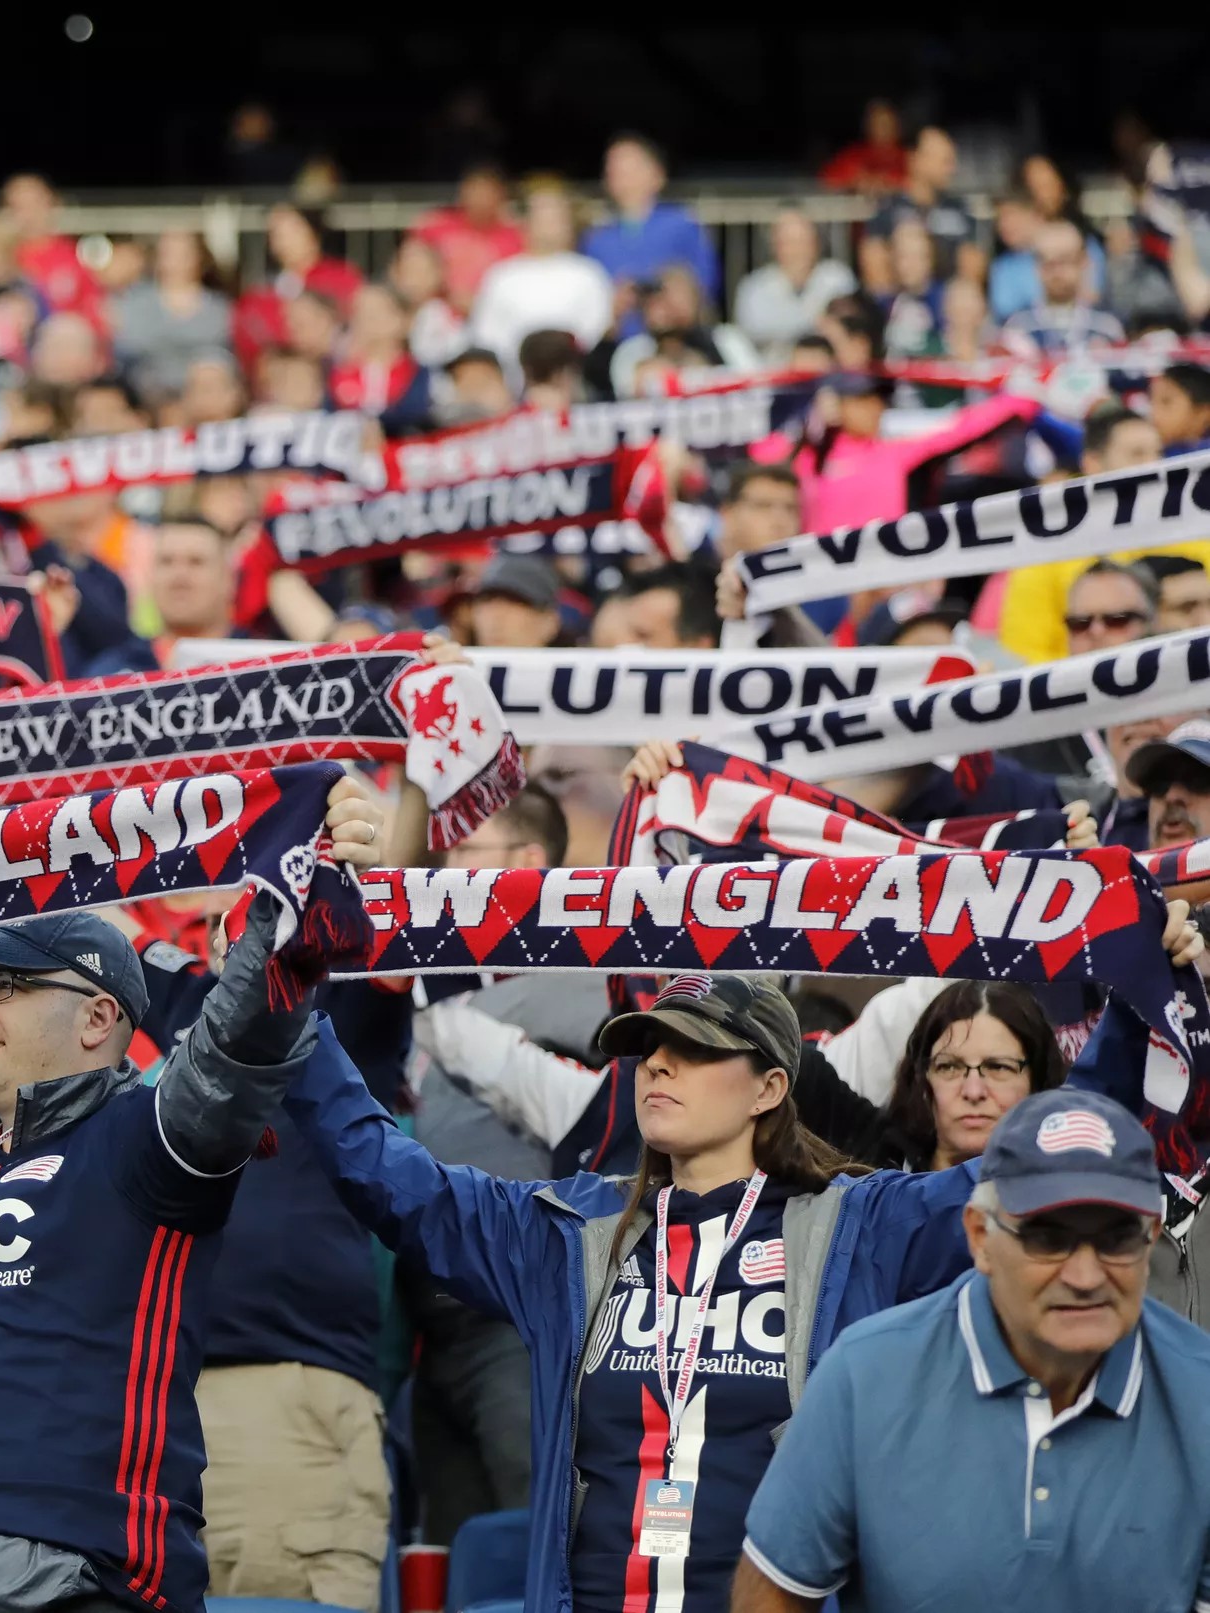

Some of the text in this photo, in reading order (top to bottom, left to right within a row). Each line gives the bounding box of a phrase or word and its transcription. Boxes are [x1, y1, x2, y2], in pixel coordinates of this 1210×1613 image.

[743, 467, 1210, 580] EVOLUTI
[88, 676, 356, 751] ENGLAND
[537, 853, 1106, 944] ENGLAND
[75, 954, 104, 977] adidas
[730, 1188, 758, 1240] REVOLUTION
[748, 1179, 762, 1190] NE
[657, 1249, 665, 1321] NE REVOLUTION
[676, 1323, 701, 1401] NE REVOLUTION
[648, 1510, 687, 1518] REVOLUTION
